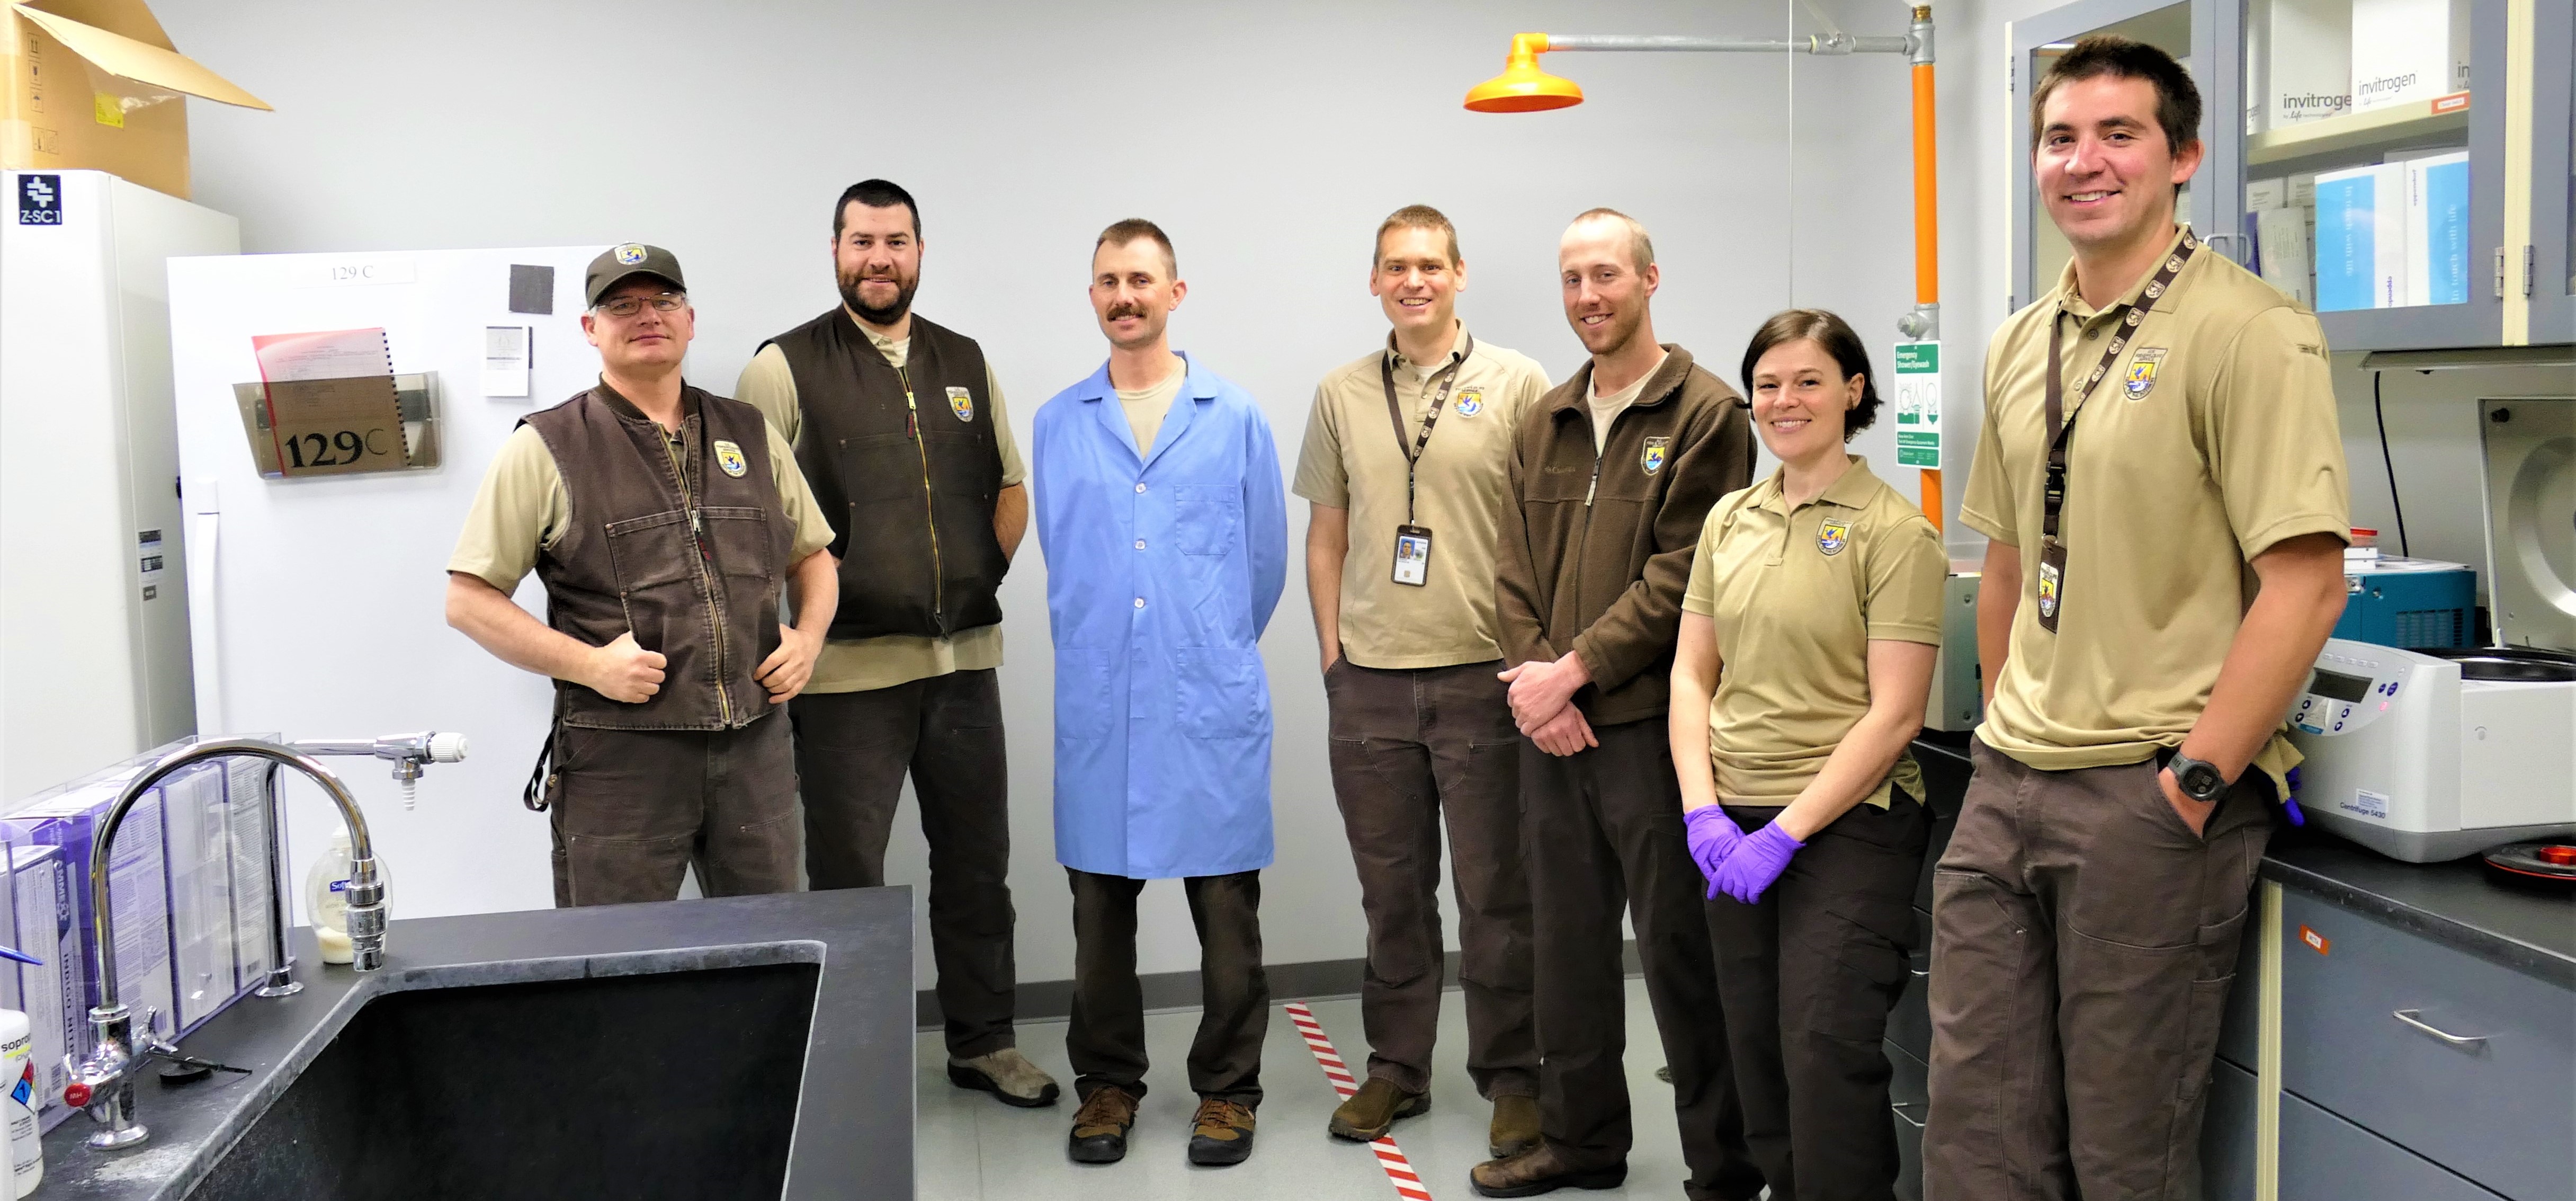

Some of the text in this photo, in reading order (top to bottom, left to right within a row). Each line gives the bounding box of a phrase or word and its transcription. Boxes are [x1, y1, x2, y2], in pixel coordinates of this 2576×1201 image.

[2358, 73, 2416, 96] invitrogen
[2283, 93, 2351, 111] invitroge
[21, 210, 60, 223] Z-SC1
[2449, 226, 2457, 250] with
[333, 265, 373, 280] 129 C
[2340, 802, 2386, 819] Centrifuge 5430
